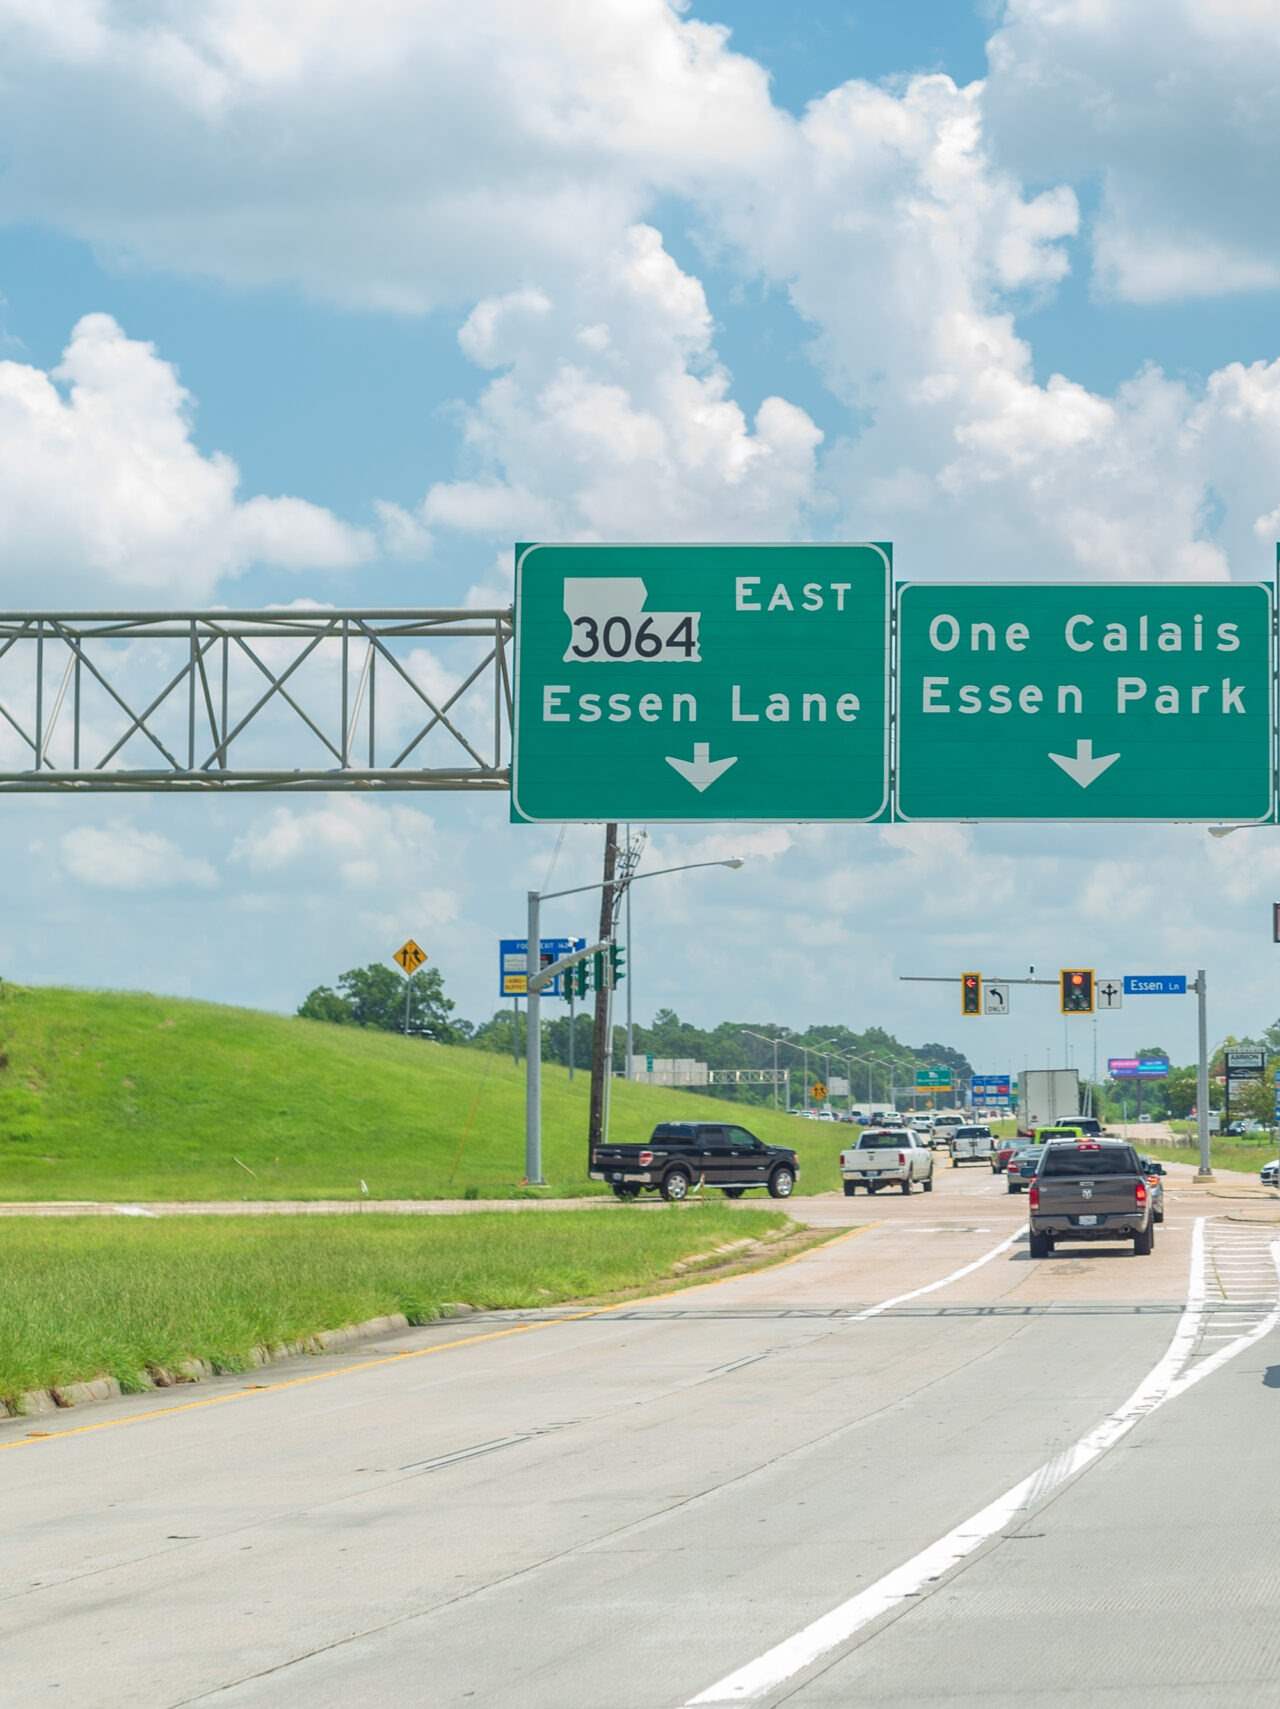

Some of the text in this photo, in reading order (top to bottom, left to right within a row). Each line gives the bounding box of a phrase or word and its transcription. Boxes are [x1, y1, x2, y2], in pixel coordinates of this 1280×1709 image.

[735, 576, 852, 612] EAST
[571, 616, 696, 658] 3064
[929, 613, 1241, 652] One Calais
[542, 685, 861, 722] Essen Lane
[922, 676, 1247, 714] Essen Park
[1130, 979, 1181, 991] Essen Ln
